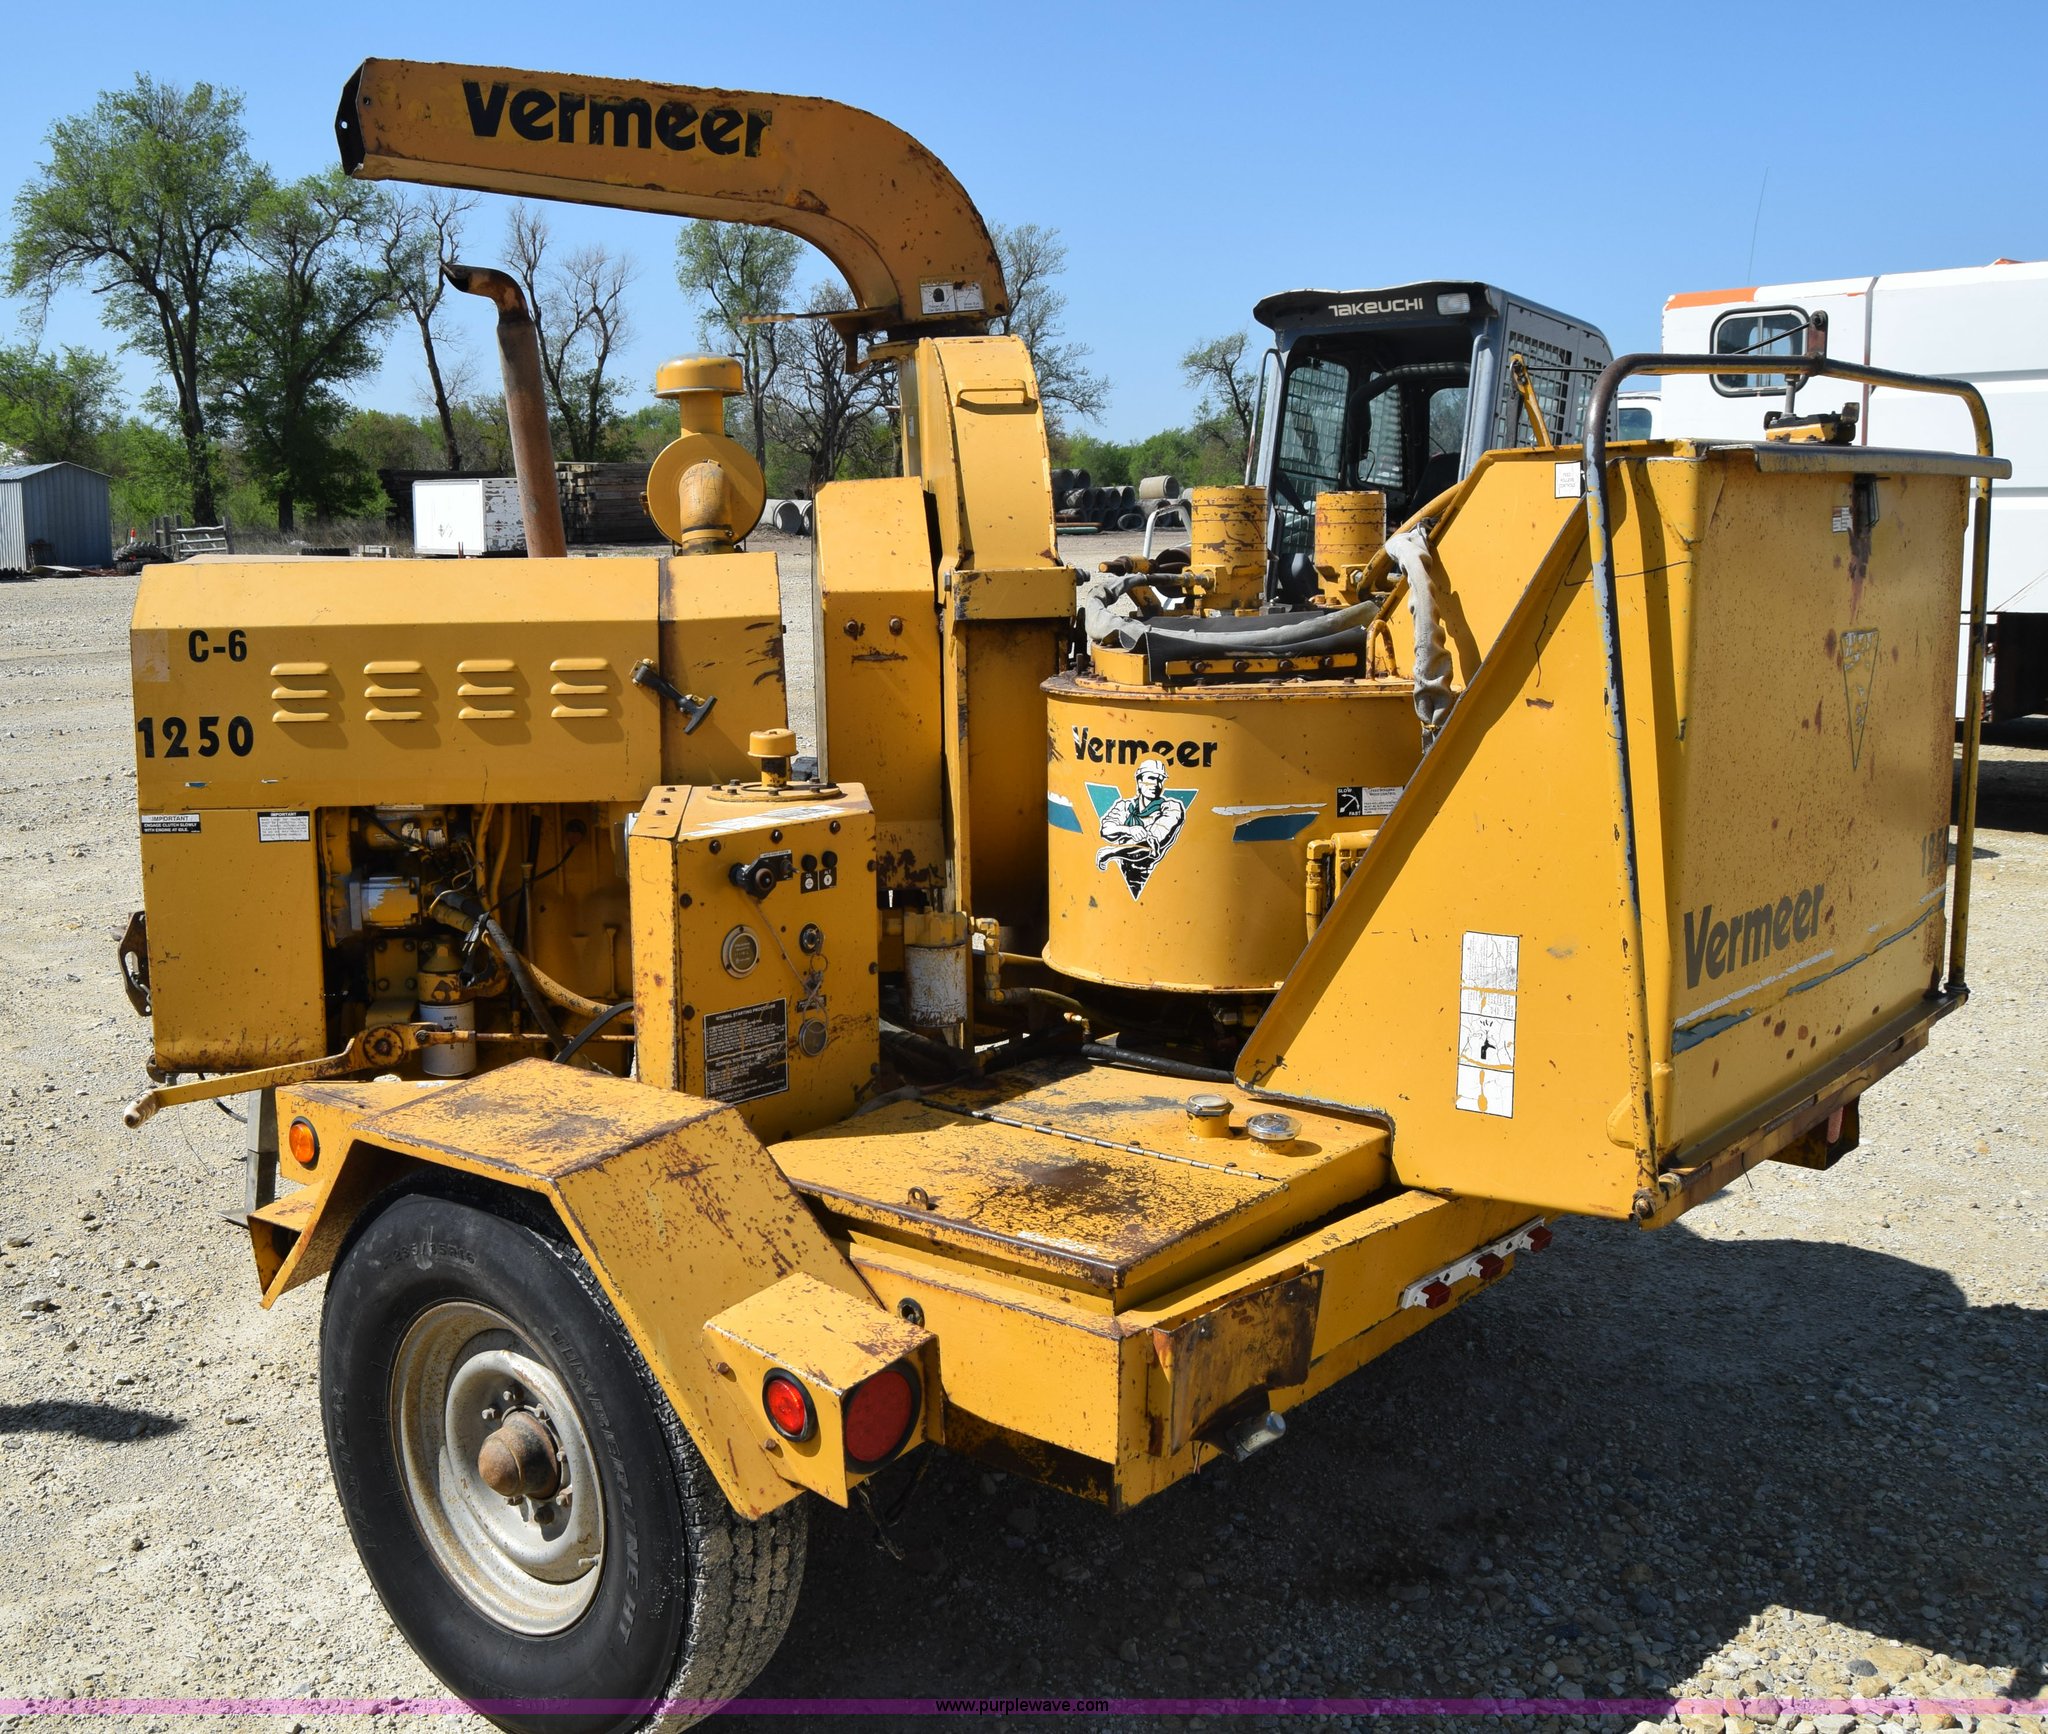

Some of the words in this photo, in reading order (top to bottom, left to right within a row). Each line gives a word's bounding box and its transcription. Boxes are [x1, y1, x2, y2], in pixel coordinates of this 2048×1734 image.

[462, 79, 773, 158] Vermeer
[1328, 297, 1424, 317] TAKEUCHI
[188, 629, 247, 663] C-6
[137, 716, 254, 758] 1250
[1071, 726, 1218, 768] Vermeer
[1684, 884, 1825, 990] Vermeer
